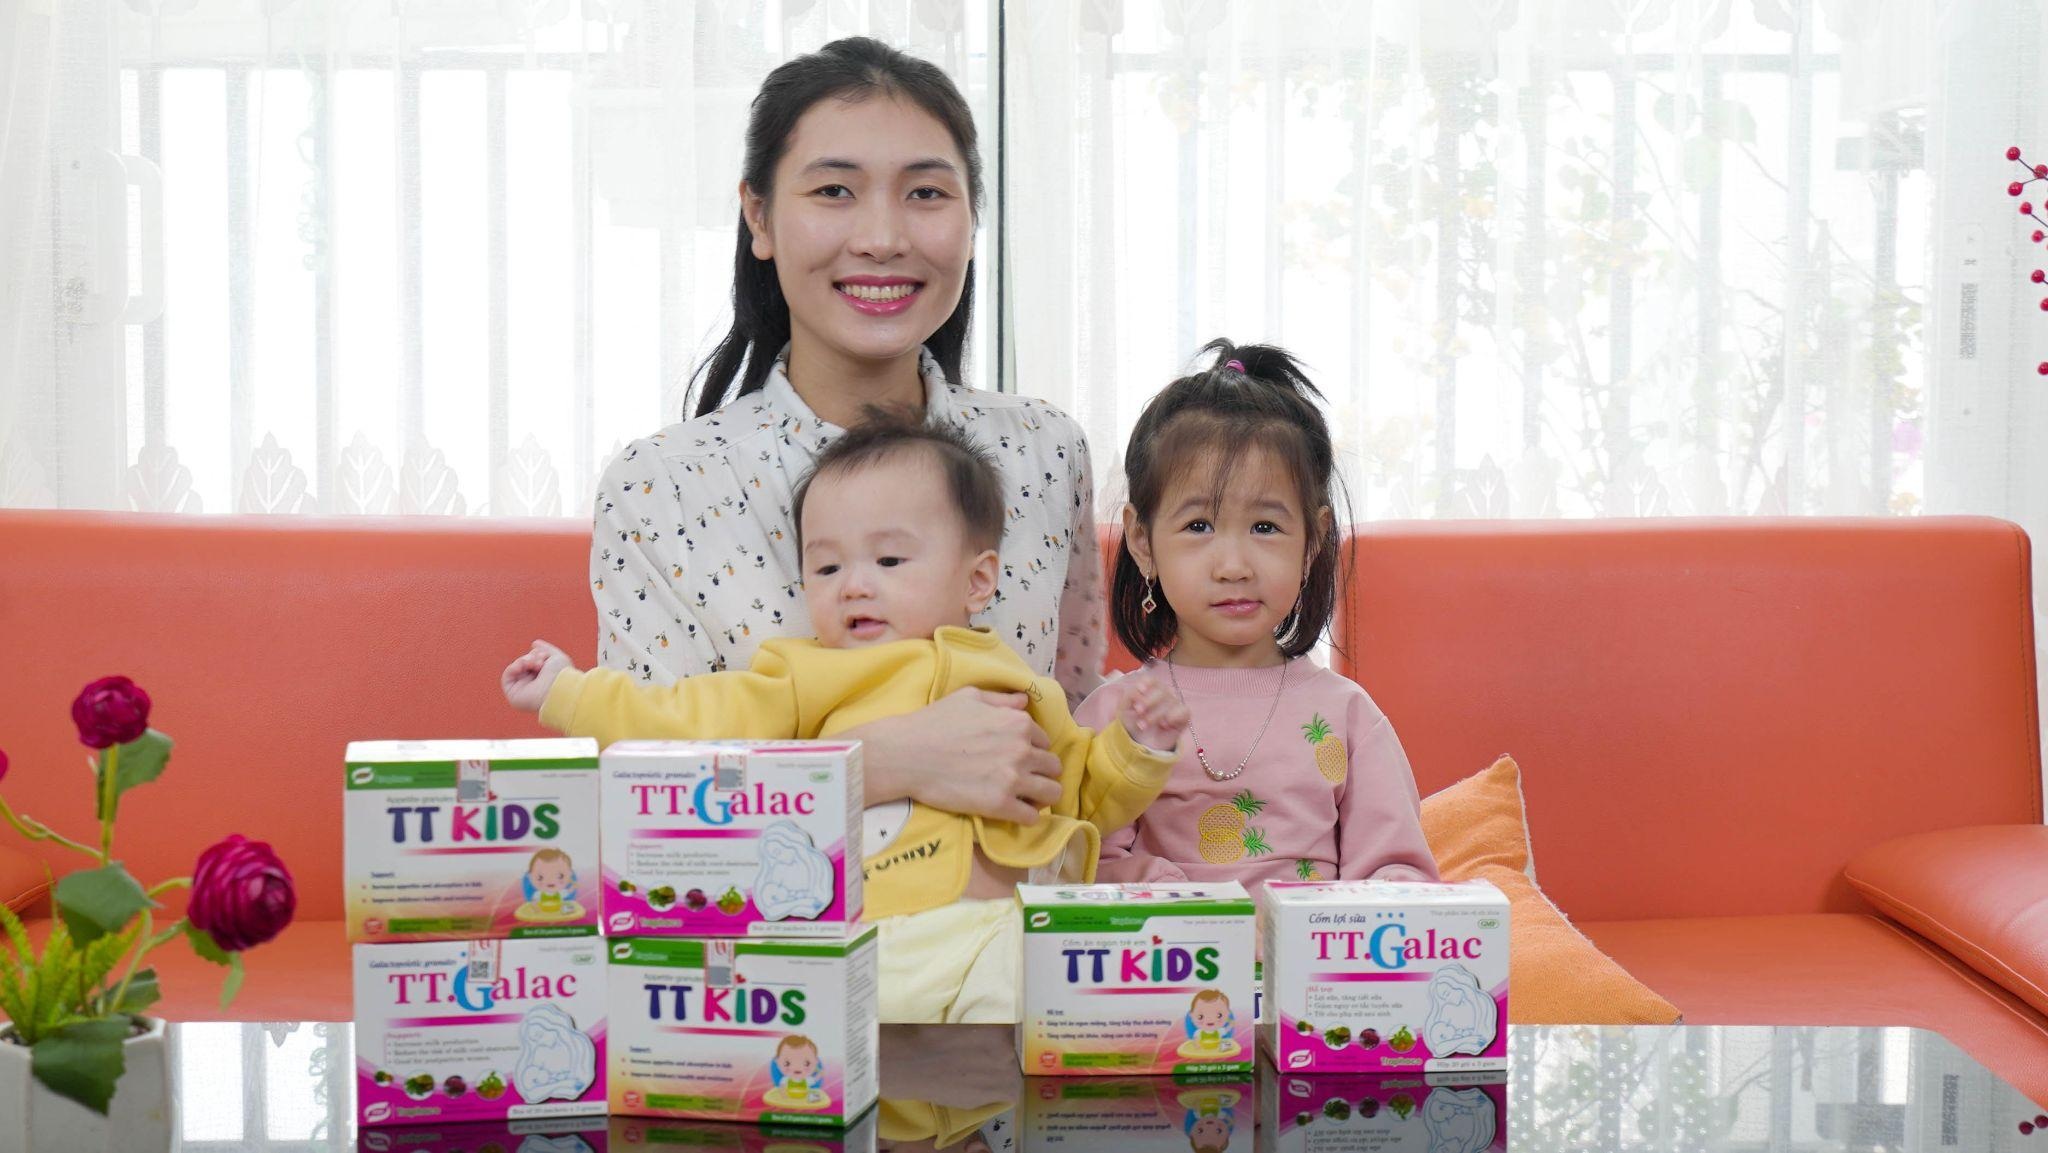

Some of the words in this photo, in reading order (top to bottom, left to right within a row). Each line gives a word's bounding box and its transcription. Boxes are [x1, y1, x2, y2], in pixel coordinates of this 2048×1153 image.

[630, 776, 815, 826] TT.Galac
[386, 806, 440, 843] TT
[1309, 911, 1331, 924] Cốm
[1311, 923, 1483, 970] TT.Galac
[1062, 949, 1111, 983] TT
[388, 965, 577, 1012] TT.Galac
[643, 984, 693, 1021] TT
